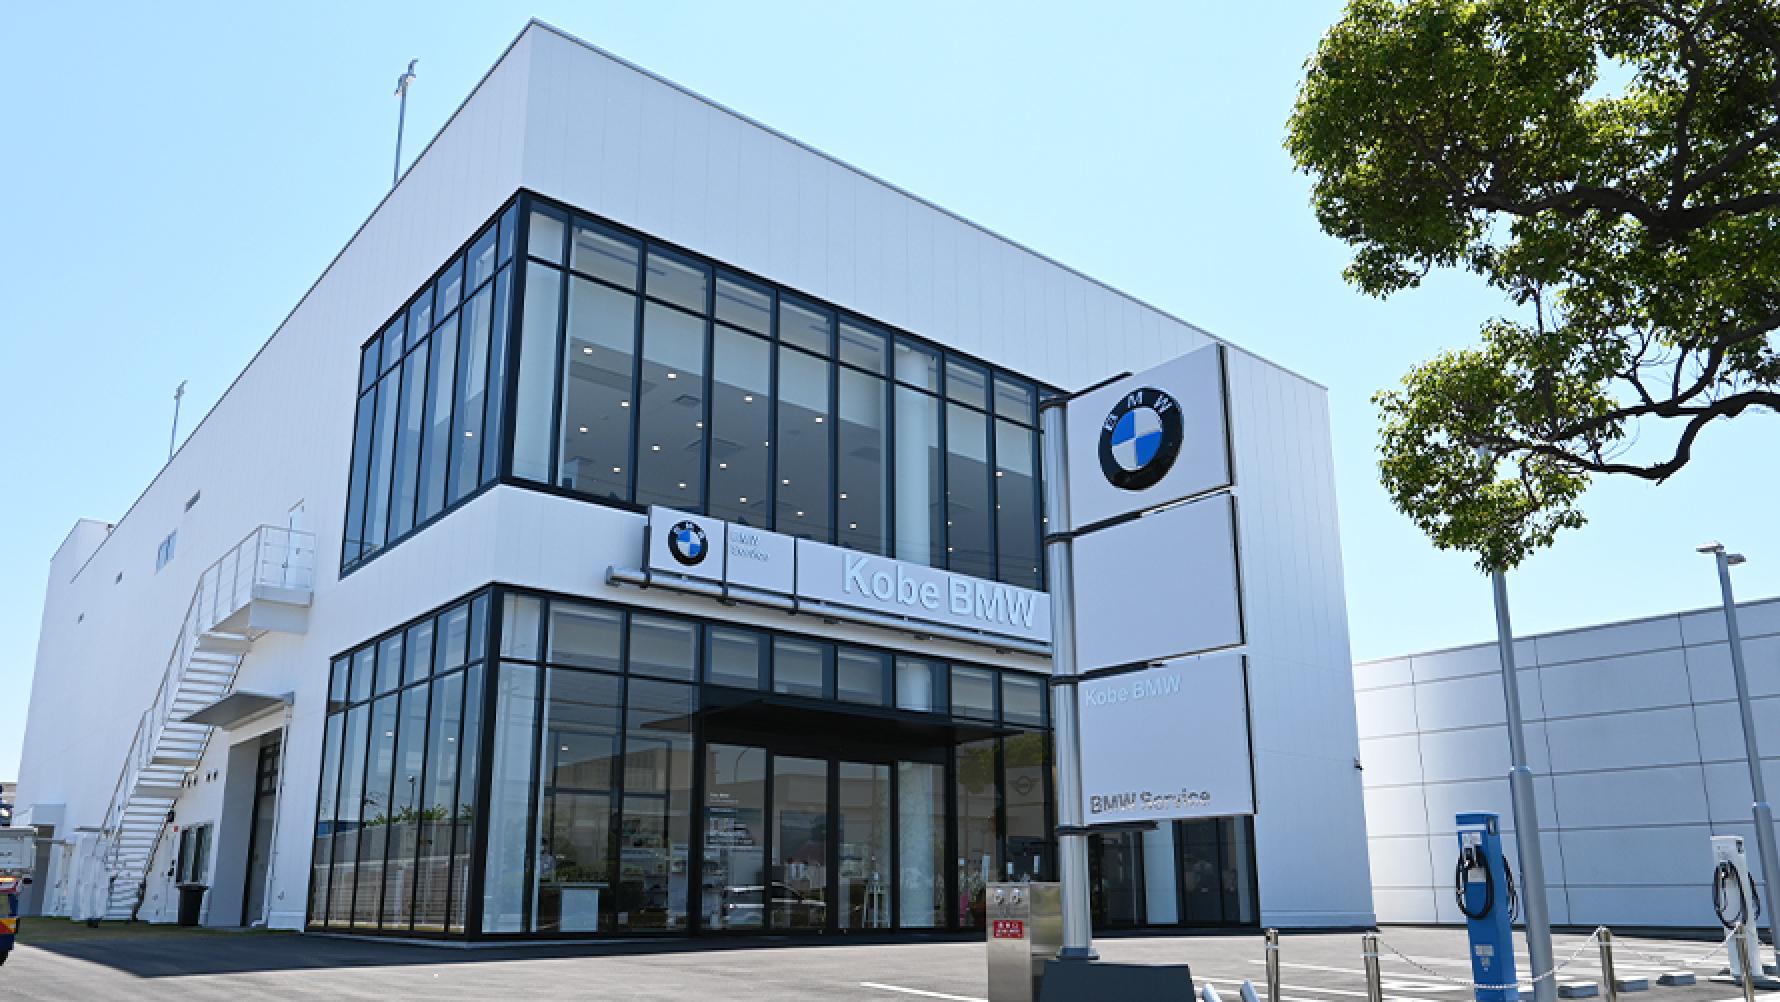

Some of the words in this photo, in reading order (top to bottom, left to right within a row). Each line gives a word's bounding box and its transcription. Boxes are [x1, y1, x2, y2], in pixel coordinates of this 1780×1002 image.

[1103, 392, 1173, 431] BMW
[842, 553, 939, 610] Kobe
[948, 575, 1036, 630] BMW
[1086, 686, 1129, 706] Kobe
[1134, 676, 1182, 699] BMW
[1090, 791, 1137, 814] BMW
[1140, 787, 1211, 811] Service
